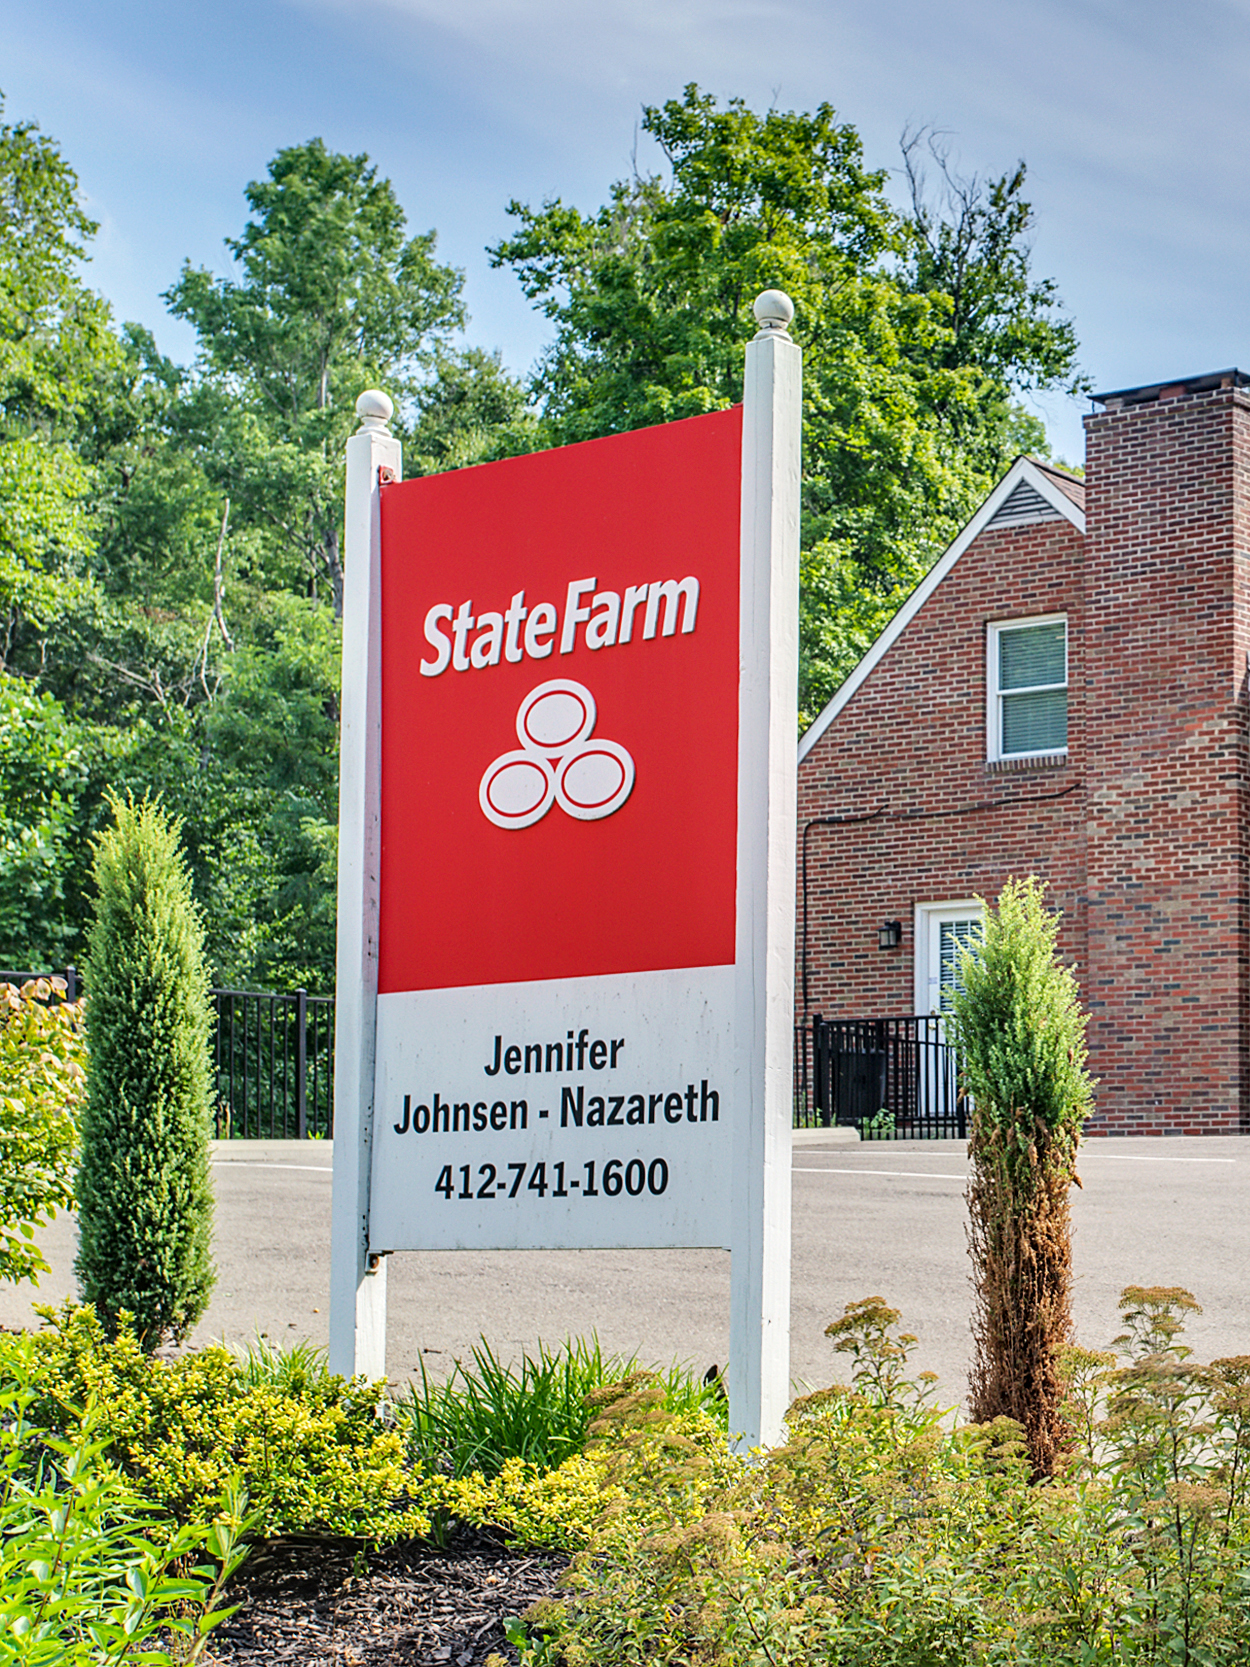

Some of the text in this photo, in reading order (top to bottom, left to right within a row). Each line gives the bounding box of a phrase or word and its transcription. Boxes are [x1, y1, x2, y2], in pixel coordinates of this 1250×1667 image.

[484, 1029, 625, 1077] Jennifer
[393, 1093, 528, 1135] Johnsen
[560, 1080, 720, 1128] Nazareth
[434, 1157, 669, 1200] 412-741-1600
